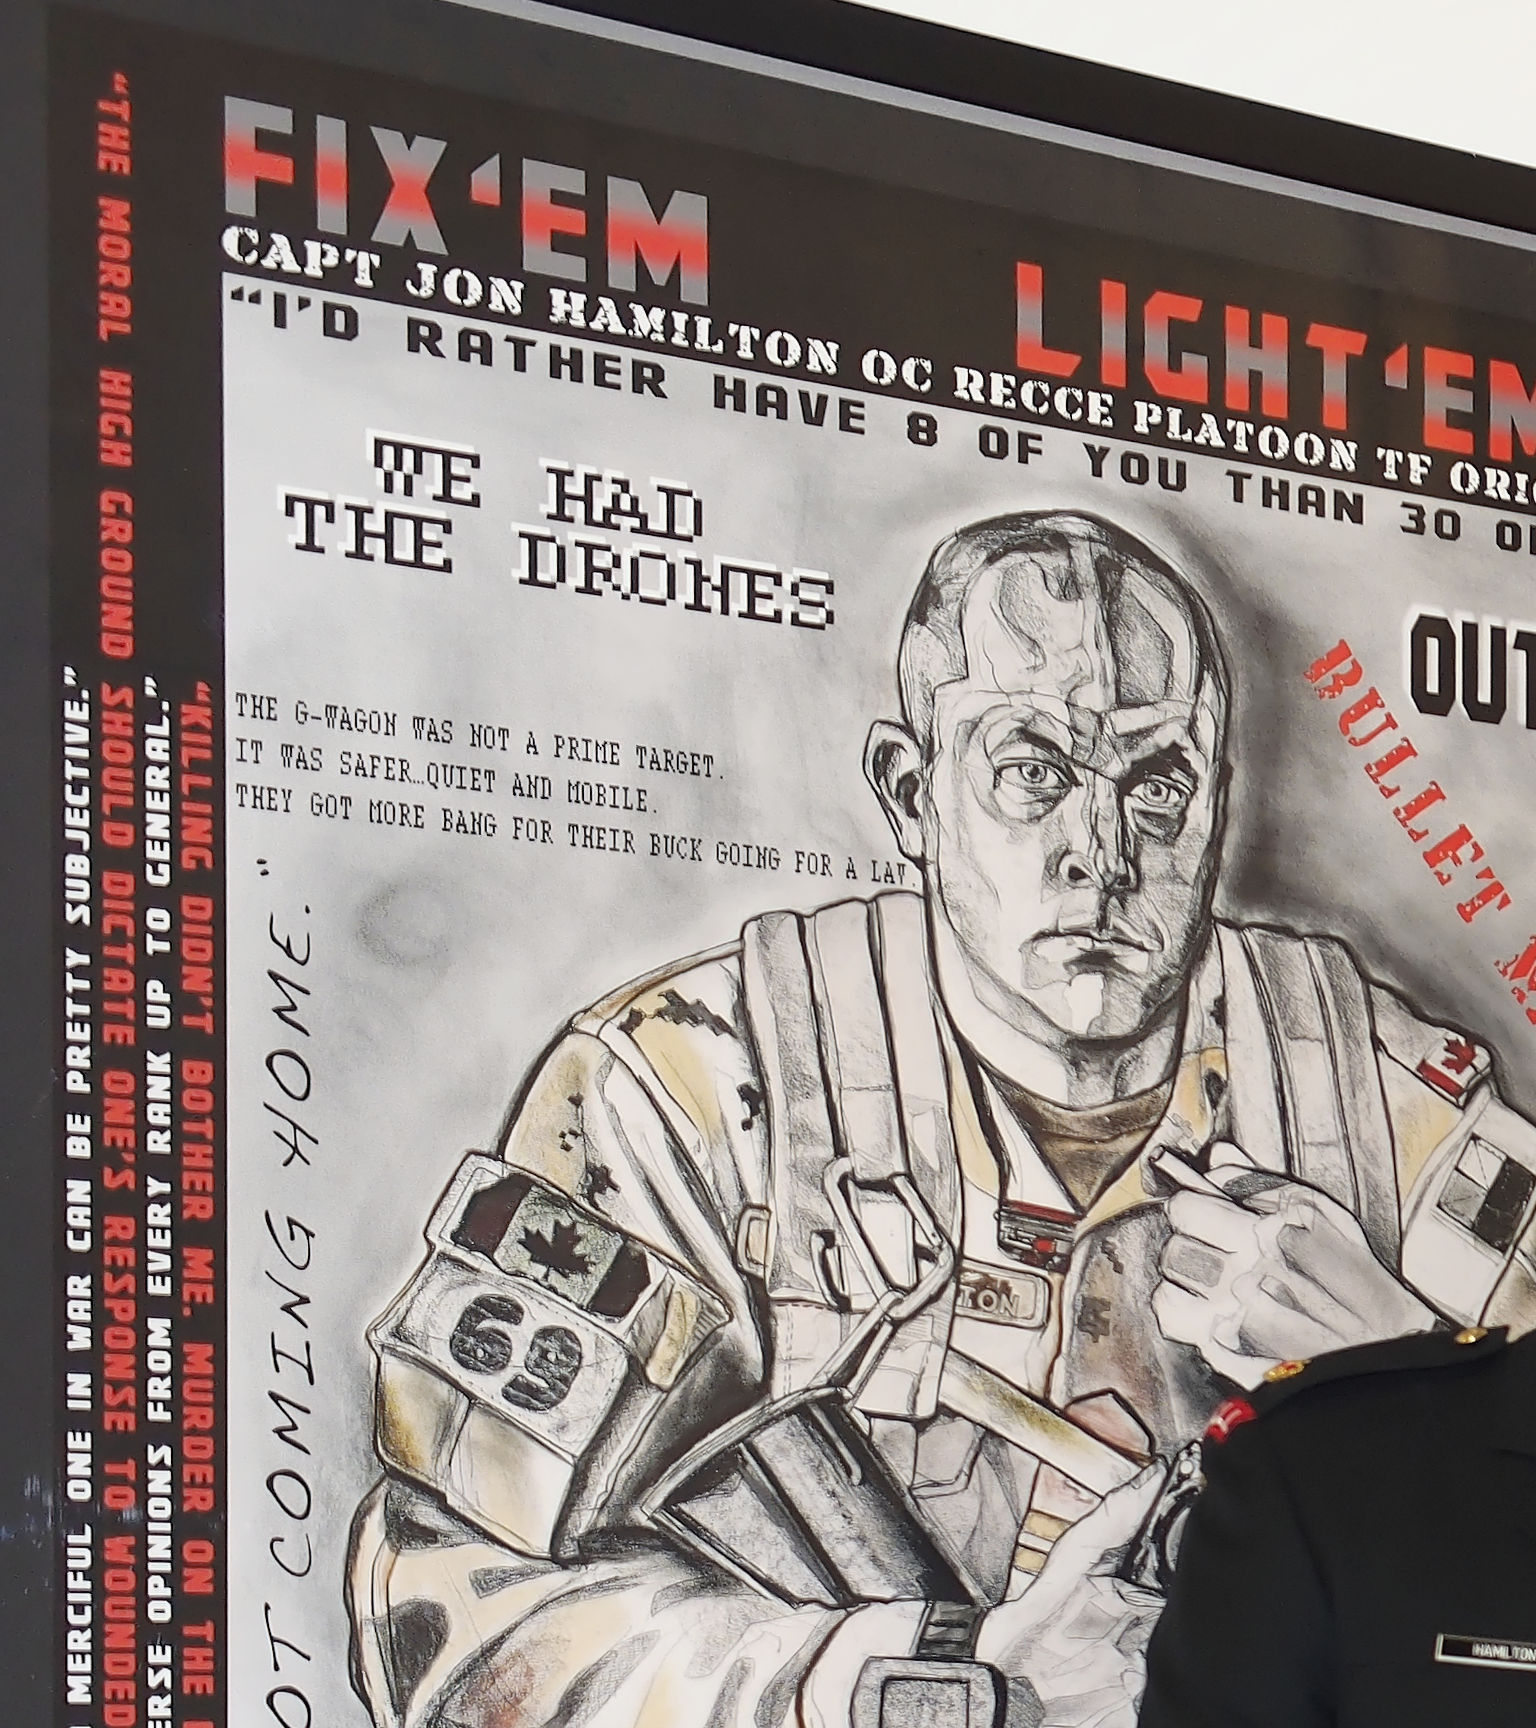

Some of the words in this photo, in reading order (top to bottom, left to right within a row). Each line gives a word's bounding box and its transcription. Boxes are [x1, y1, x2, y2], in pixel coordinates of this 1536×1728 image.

[95, 195, 133, 341] MORAL
[222, 225, 380, 288] CAPT
[406, 261, 525, 316] JON
[549, 287, 839, 375] HAMILTON
[861, 348, 932, 393] OC
[953, 366, 1113, 428] RECCE
[1133, 400, 1358, 473] PLATOON
[1376, 446, 1432, 486] TF
[96, 367, 134, 468] HIGH
[406, 316, 668, 400] RATHER
[713, 373, 866, 436] HAVE
[907, 411, 938, 448] 8
[978, 424, 1043, 465] OF
[1082, 442, 1188, 493] YOU
[1225, 468, 1364, 526] THAN
[1399, 501, 1462, 542] 30
[370, 434, 481, 508] WE
[546, 463, 702, 542] HAD
[97, 488, 135, 660] GROUND
[281, 490, 453, 575] THE
[514, 525, 836, 630] DRONES
[98, 683, 136, 849] SHOULD
[235, 692, 279, 722] THE
[295, 699, 398, 737] G-WAGON
[412, 715, 453, 745] WAS
[469, 722, 510, 752] NOT
[526, 730, 539, 756] A
[553, 734, 620, 766] PRIME
[635, 744, 724, 780] TARGET.
[235, 737, 263, 765] IT
[280, 743, 323, 773] WAS
[512, 774, 552, 801] AND
[567, 781, 658, 815] MOBILE.
[1303, 638, 1512, 924] BULLET
[235, 783, 293, 814] THEY
[310, 792, 352, 821] GOT
[368, 799, 425, 830] MORE
[441, 807, 497, 838] BANG
[512, 816, 554, 844] FOR
[567, 822, 636, 855] THEIR
[649, 832, 703, 862] BUCK
[715, 840, 782, 871] GOING
[794, 849, 834, 878] FOR
[845, 856, 858, 881] A
[870, 858, 919, 887] LAV.
[100, 869, 136, 1046] DICTATE
[65, 946, 91, 1093] PRETTY
[66, 1112, 91, 1158] BE
[179, 1058, 215, 1222] BOTHER
[66, 1178, 92, 1250] CAN
[66, 1273, 92, 1351] WAR
[101, 1214, 137, 1432] RESPONSE
[180, 1246, 215, 1317] ME.
[66, 1371, 92, 1410] IN
[180, 1341, 215, 1513] MURDER
[263, 1207, 316, 1579] COMING
[66, 1430, 92, 1501] ONE
[102, 1459, 137, 1511] TO
[66, 1522, 92, 1703] MERCIFUL
[180, 1538, 215, 1596] ON
[180, 1621, 215, 1695] THE
[1472, 1643, 1536, 1662] HAMILTON
